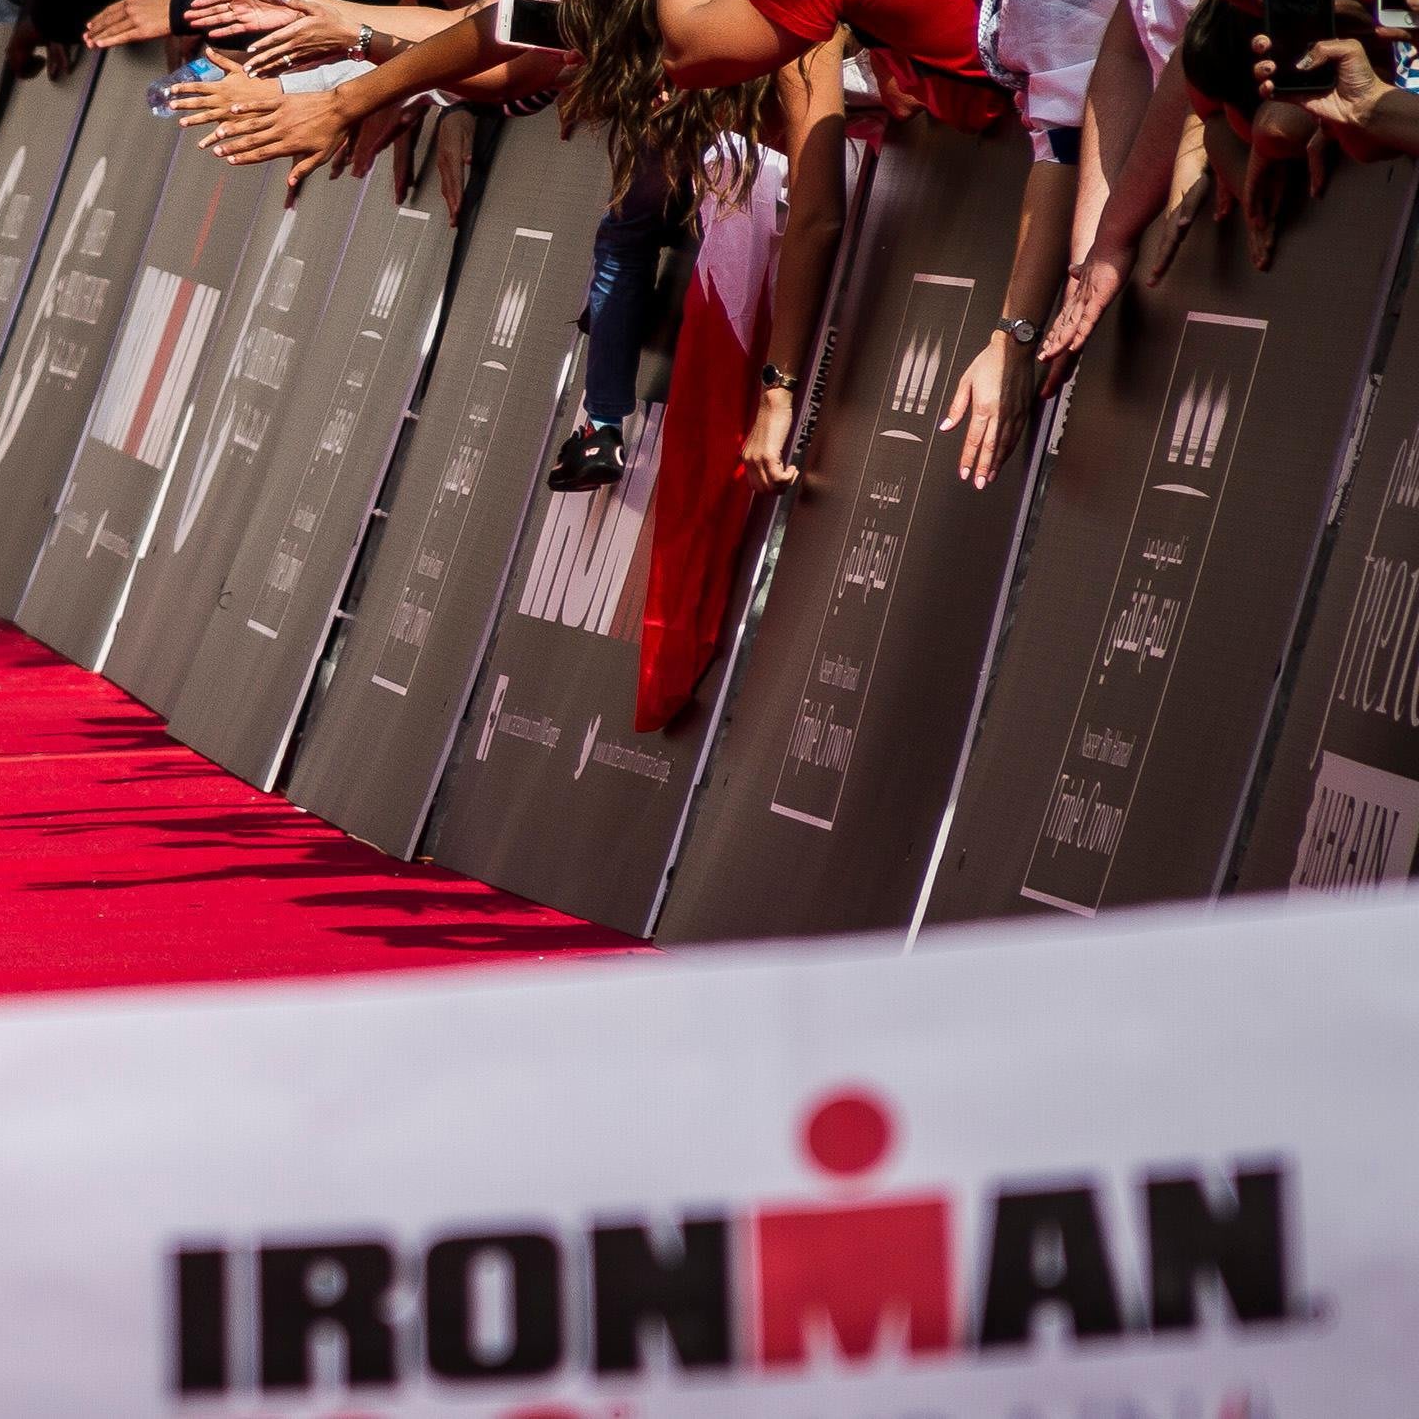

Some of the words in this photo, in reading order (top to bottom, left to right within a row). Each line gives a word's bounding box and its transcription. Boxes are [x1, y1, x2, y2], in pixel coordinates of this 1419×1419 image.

[789, 698, 822, 775] Triple
[815, 704, 852, 772] Crown
[1047, 774, 1085, 858] Triple
[1077, 781, 1122, 856] Crown
[171, 1080, 1294, 1398] IRONMAN
